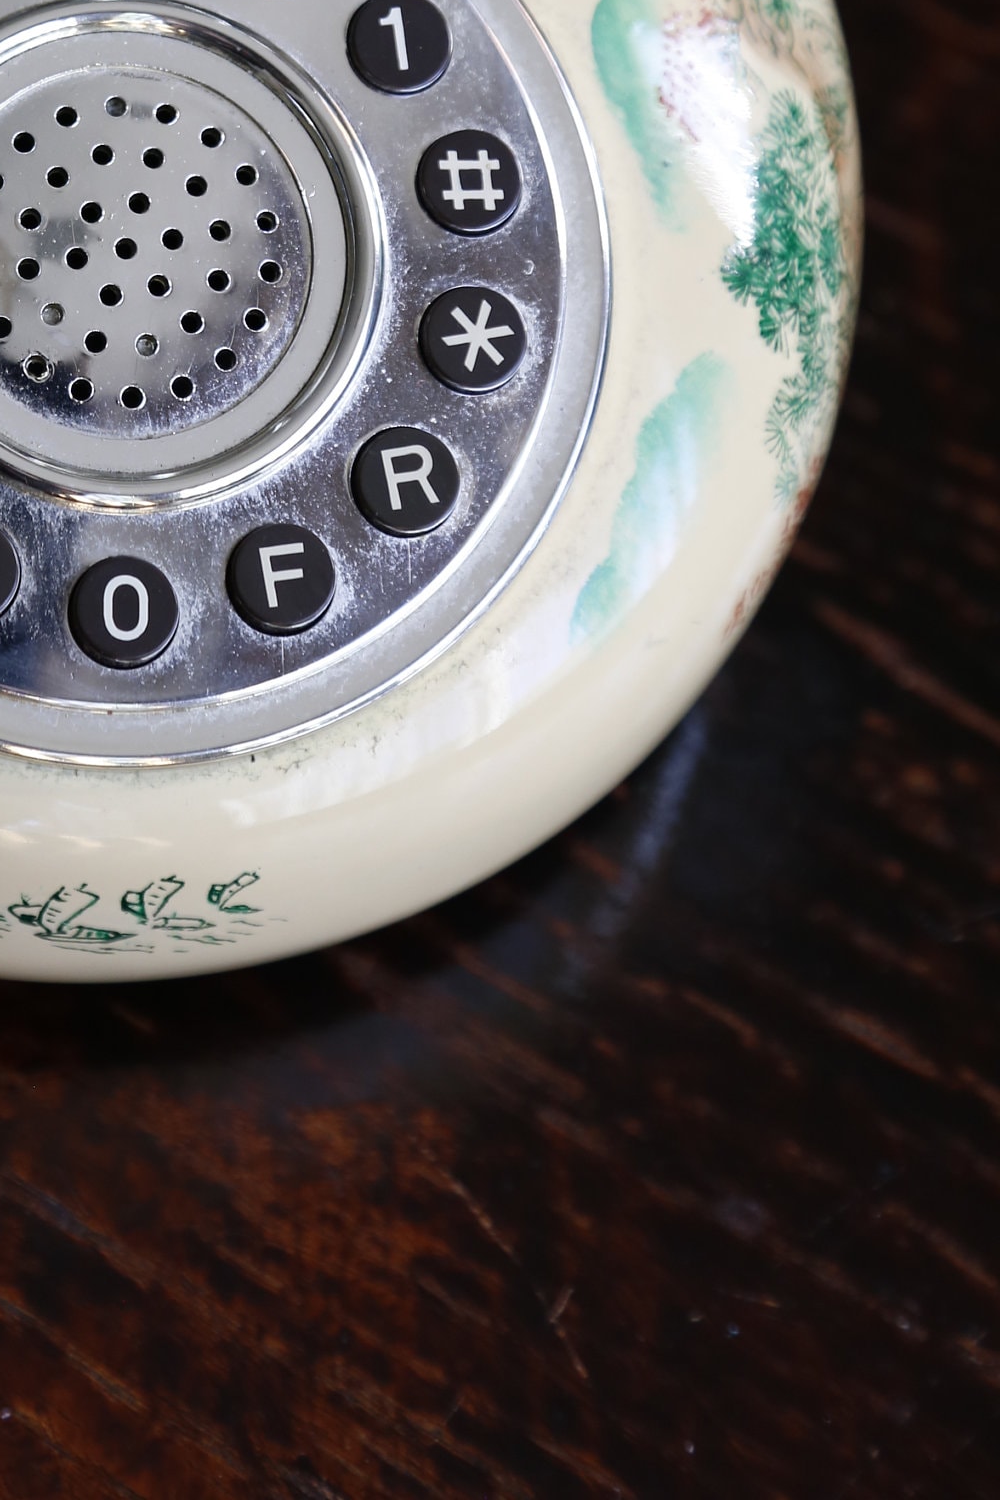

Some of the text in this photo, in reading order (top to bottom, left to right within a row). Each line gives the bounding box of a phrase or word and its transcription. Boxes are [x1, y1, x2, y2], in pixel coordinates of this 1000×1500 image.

[379, 6, 409, 71] 1
[438, 150, 505, 211] #
[380, 444, 440, 511] R
[103, 574, 149, 642] 0
[258, 542, 305, 608] F
